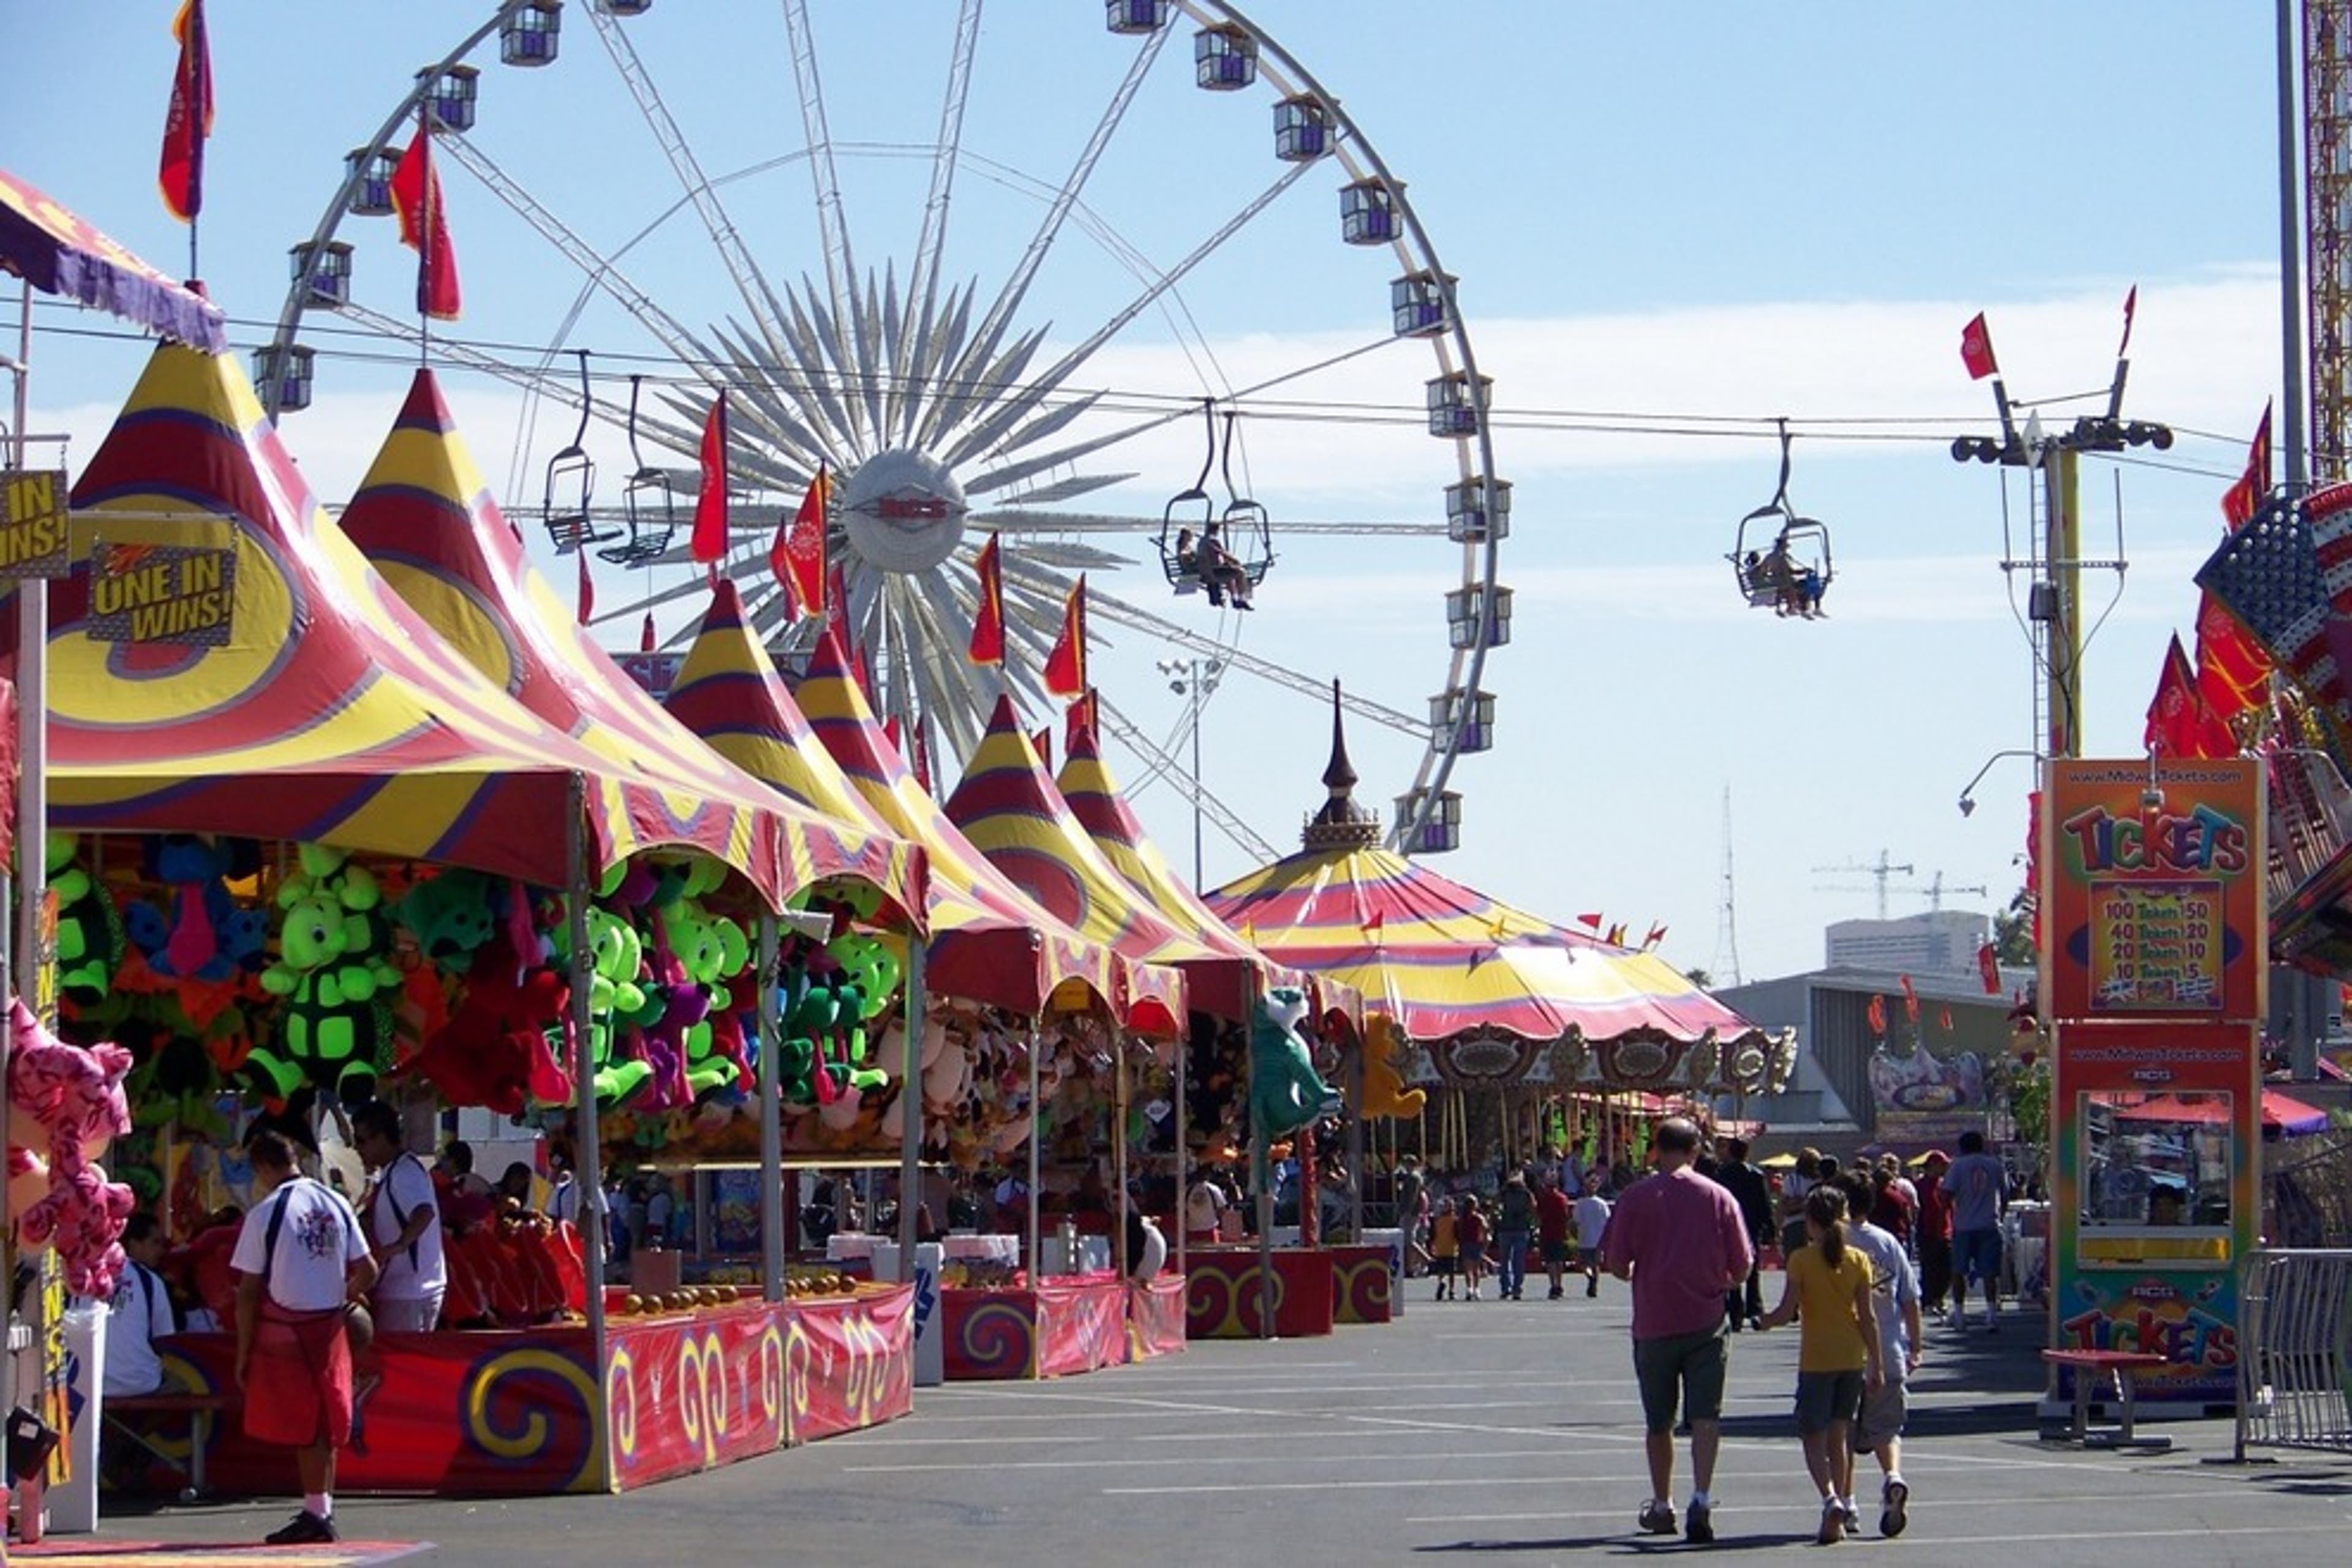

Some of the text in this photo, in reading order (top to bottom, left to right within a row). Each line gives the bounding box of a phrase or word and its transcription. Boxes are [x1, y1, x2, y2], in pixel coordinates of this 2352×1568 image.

[7, 473, 53, 522] IN
[0, 512, 66, 566] INS!
[182, 552, 221, 595] IN
[132, 590, 231, 641] WINS!
[2105, 902, 2135, 919] 100
[2111, 923, 2135, 939] 40
[2112, 943, 2135, 959] 20
[2116, 963, 2135, 979] 10
